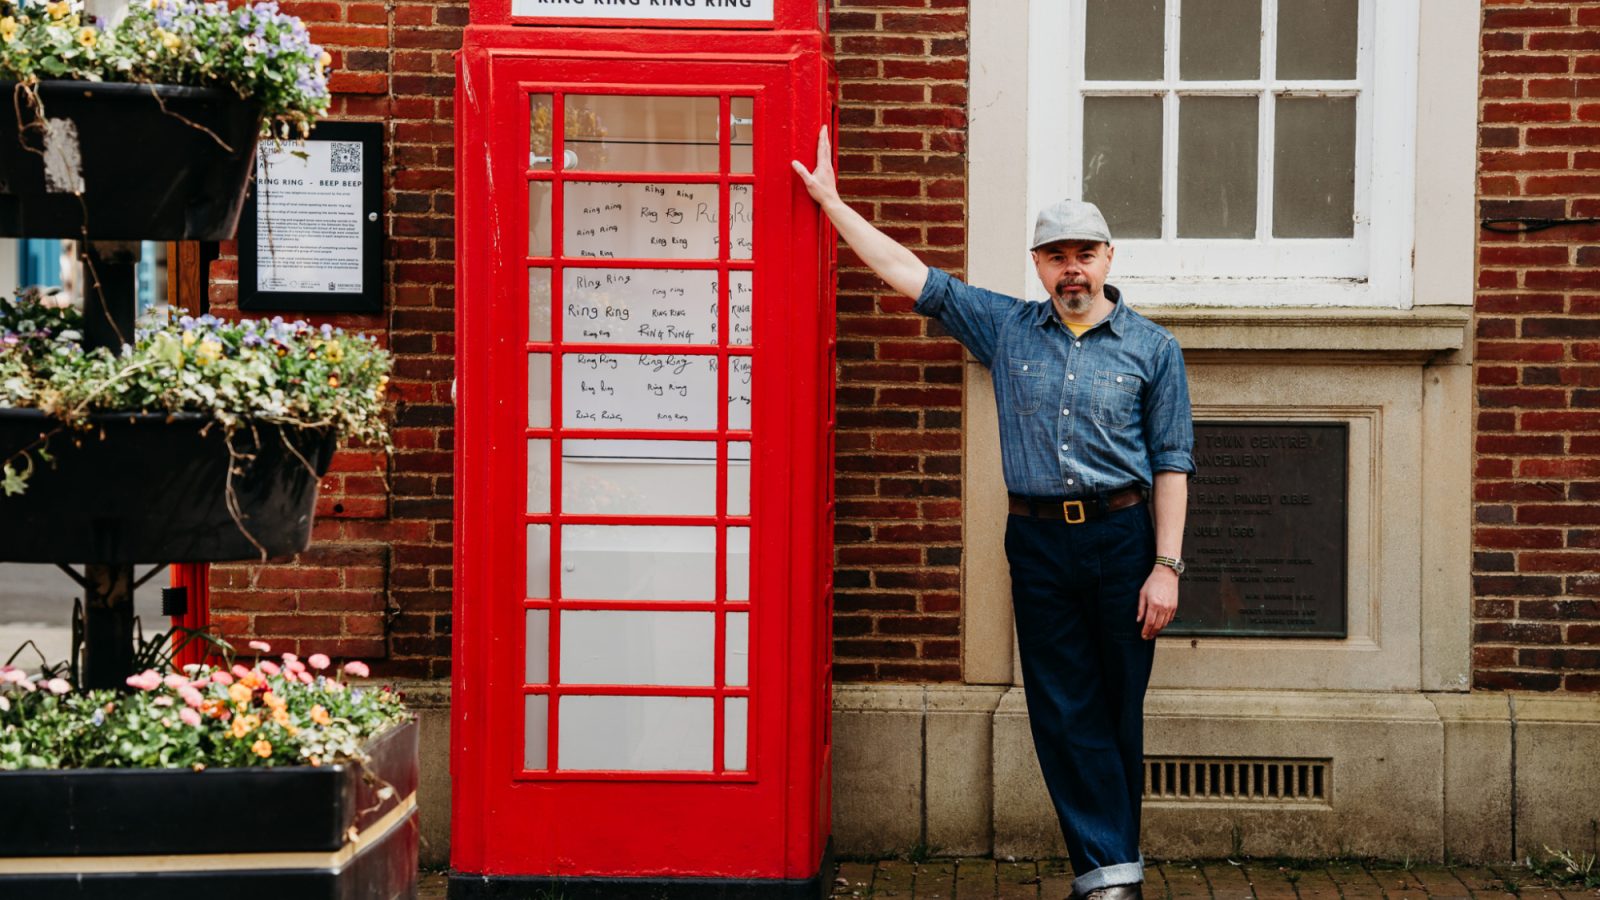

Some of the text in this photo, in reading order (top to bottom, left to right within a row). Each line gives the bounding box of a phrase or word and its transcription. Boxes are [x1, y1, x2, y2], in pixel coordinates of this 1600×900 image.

[319, 179, 339, 187] BEEP
[645, 184, 693, 200] Ring Ring
[640, 207, 683, 224] Ring Ring
[599, 225, 618, 233] Ring
[650, 236, 688, 249] Ring Ring
[581, 249, 614, 258] Ring Ring
[606, 274, 631, 284] Ring
[568, 304, 630, 320] Ring Ring
[577, 354, 618, 370] Ring Ring
[638, 354, 693, 375] Ring Ring
[581, 380, 614, 396] Ring Ring
[647, 383, 687, 397] Ring Ring
[1205, 435, 1311, 449] TOWN CENTRE
[1195, 454, 1270, 468] ANCEMENT
[1193, 527, 1223, 538] JULY
